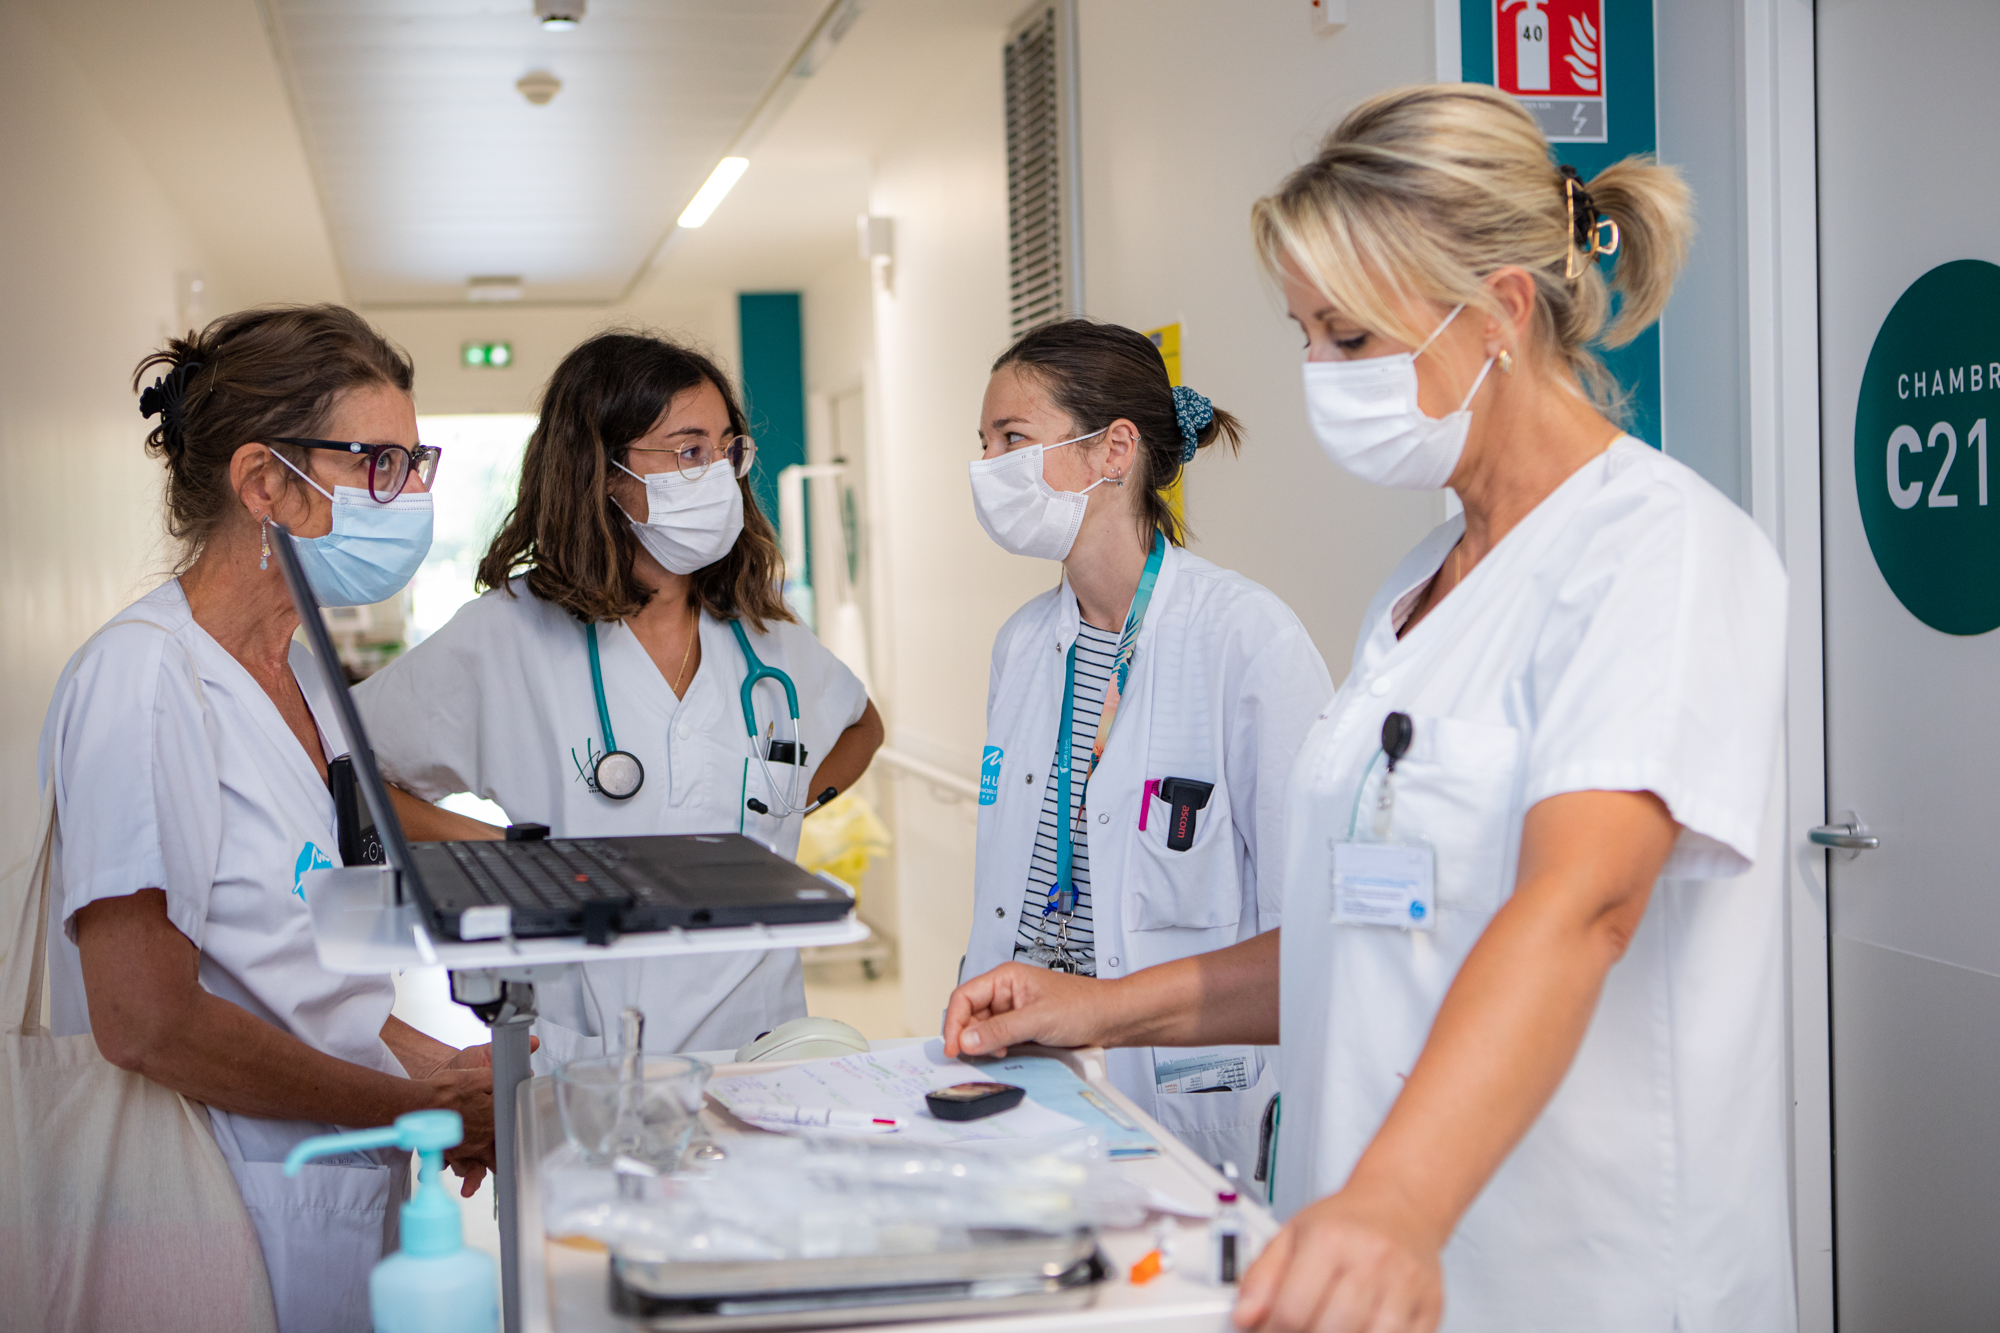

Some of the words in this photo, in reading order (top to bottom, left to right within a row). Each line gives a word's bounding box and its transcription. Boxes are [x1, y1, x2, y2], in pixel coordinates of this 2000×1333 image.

[1523, 26, 1543, 42] 40
[1897, 362, 2000, 400] CHAMBR
[1886, 418, 1988, 510] C21
[980, 775, 999, 787] HU
[1177, 805, 1190, 838] ascom
